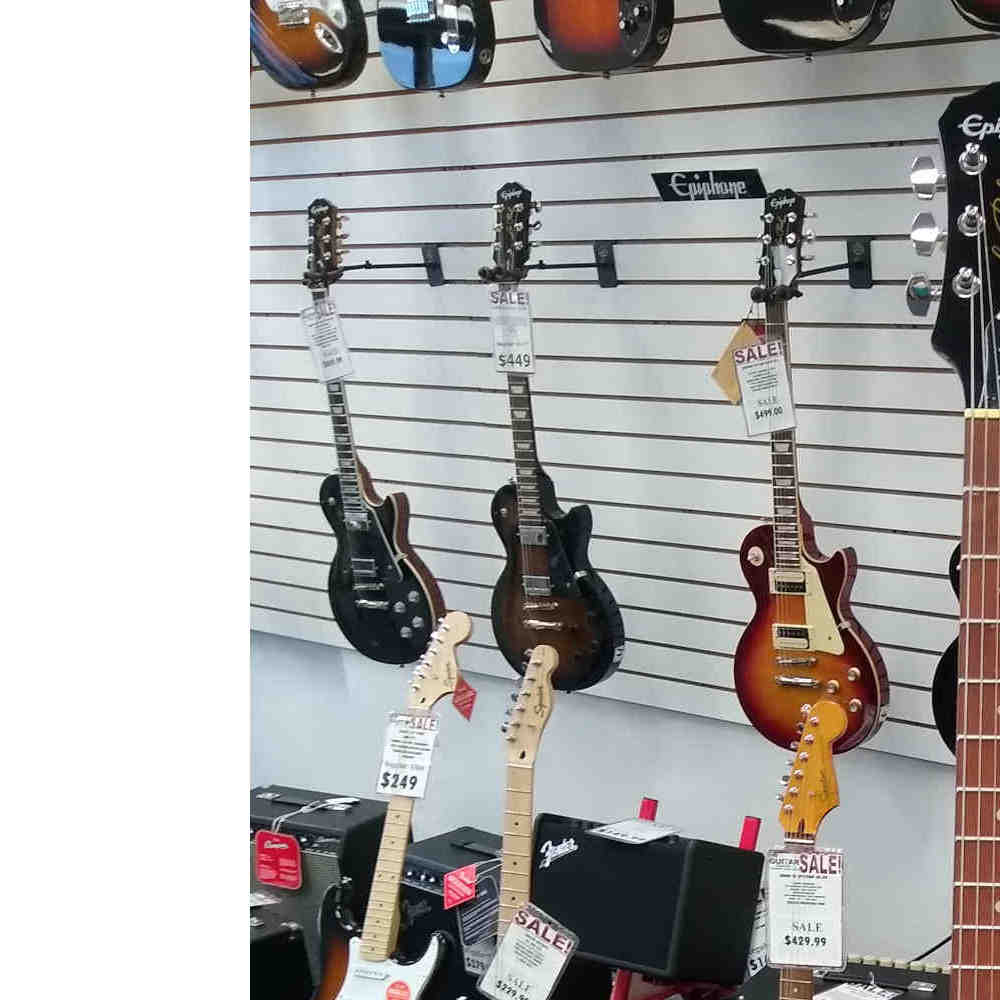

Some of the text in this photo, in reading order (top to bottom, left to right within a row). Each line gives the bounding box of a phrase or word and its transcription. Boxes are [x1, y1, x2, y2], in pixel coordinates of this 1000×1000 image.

[668, 171, 747, 200] Epiphone
[498, 353, 530, 367] $449
[380, 771, 418, 790] $249
[539, 838, 579, 869] Fender
[515, 910, 572, 954] SALE!
[792, 921, 823, 932] SALE
[784, 935, 827, 947] $429.99
